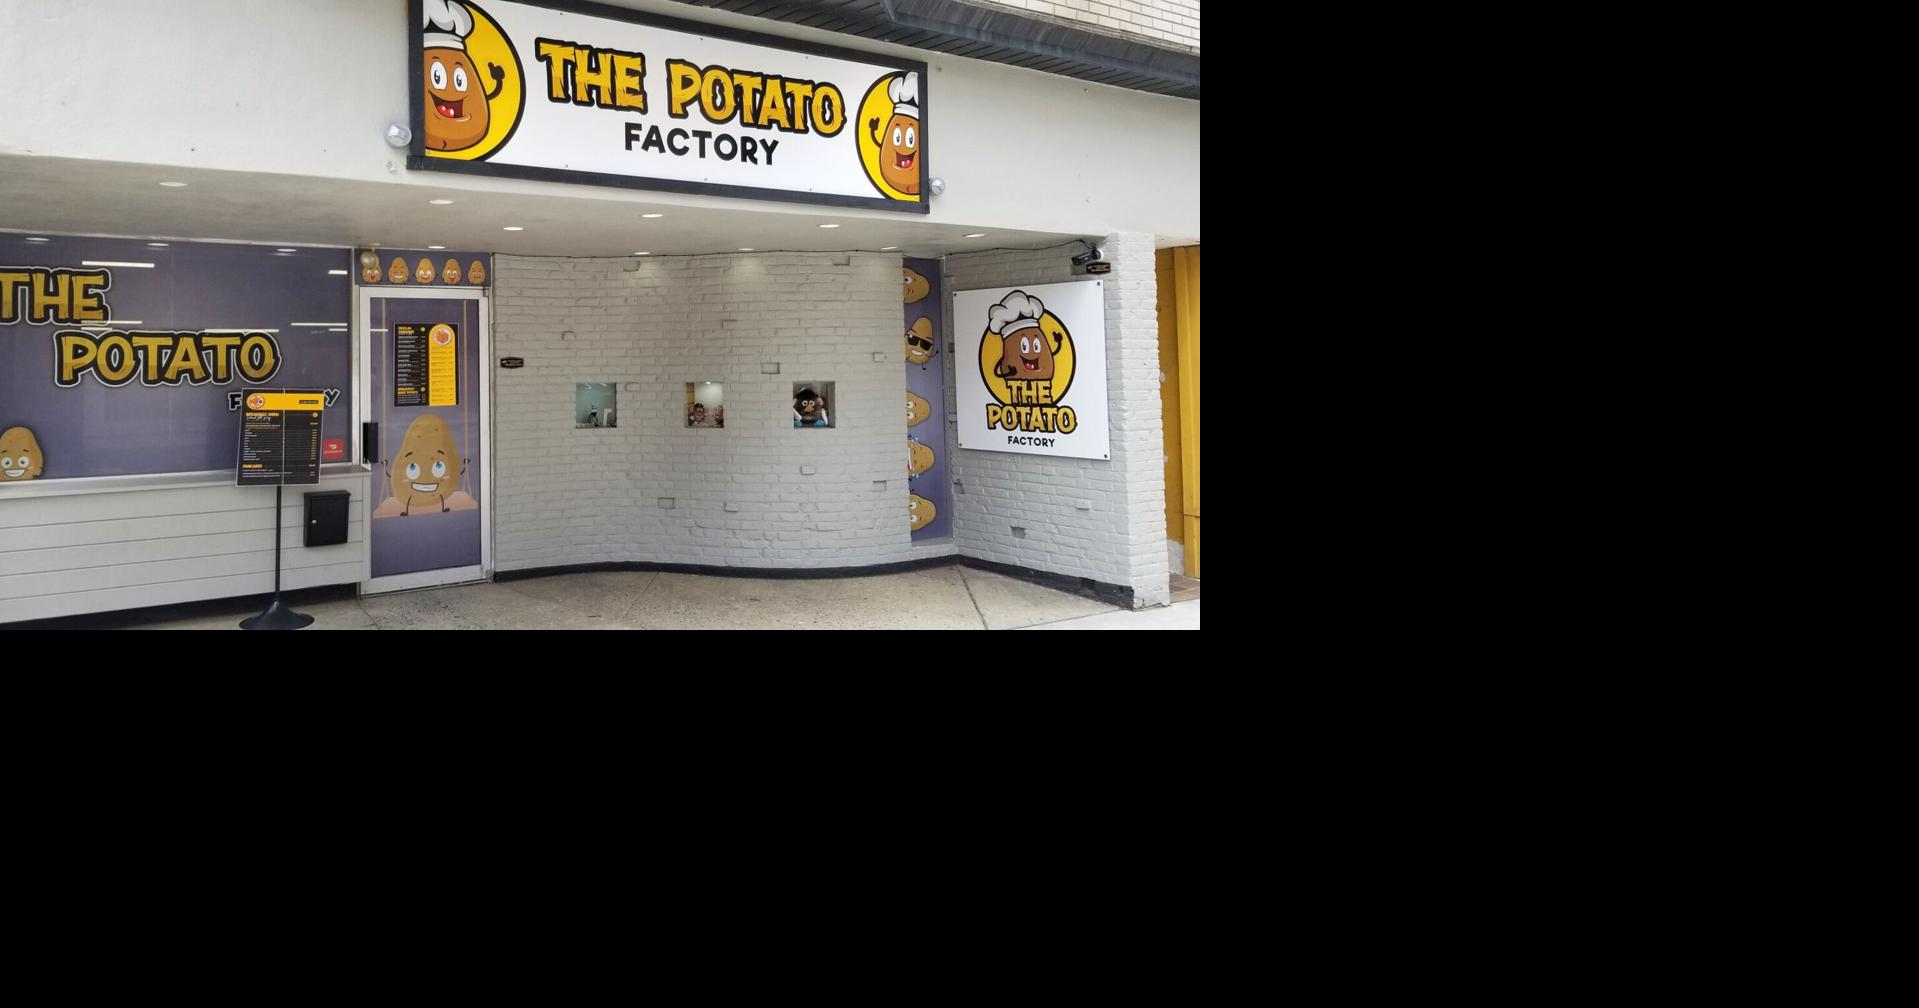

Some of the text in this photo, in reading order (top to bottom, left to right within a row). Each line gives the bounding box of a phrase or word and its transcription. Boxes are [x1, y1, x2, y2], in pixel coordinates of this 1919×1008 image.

[535, 37, 846, 138] THE POTATO
[624, 122, 779, 166] FACTORY
[0, 268, 110, 325] THE
[55, 331, 281, 387] POTATO
[1006, 379, 1054, 405] THE
[986, 403, 1077, 434] POTATO
[1007, 435, 1056, 448] FACTORY
